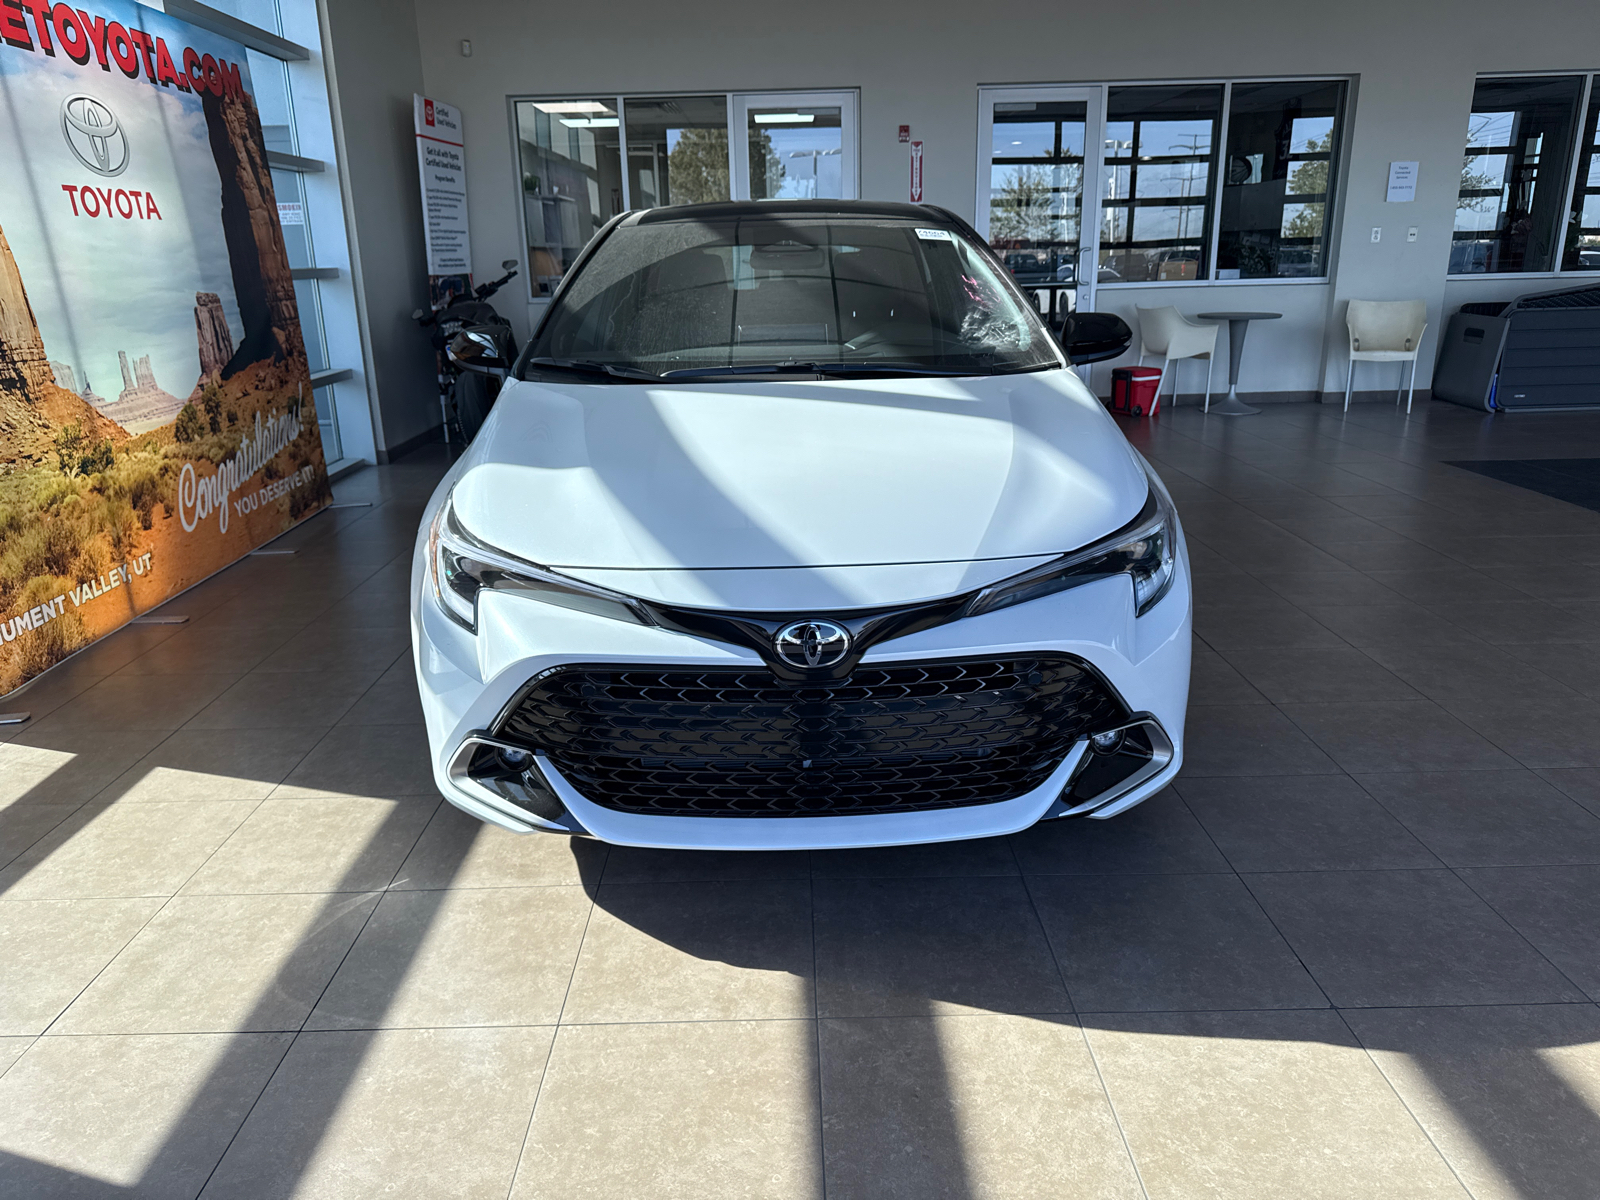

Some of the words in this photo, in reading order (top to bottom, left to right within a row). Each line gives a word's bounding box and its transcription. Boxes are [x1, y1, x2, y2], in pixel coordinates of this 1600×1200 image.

[62, 184, 162, 220] TOYOTA
[234, 492, 258, 518] YOU
[259, 470, 302, 506] DESERVE
[301, 464, 316, 484] IT!
[68, 563, 132, 608] VALLEY,
[132, 552, 152, 576] UT
